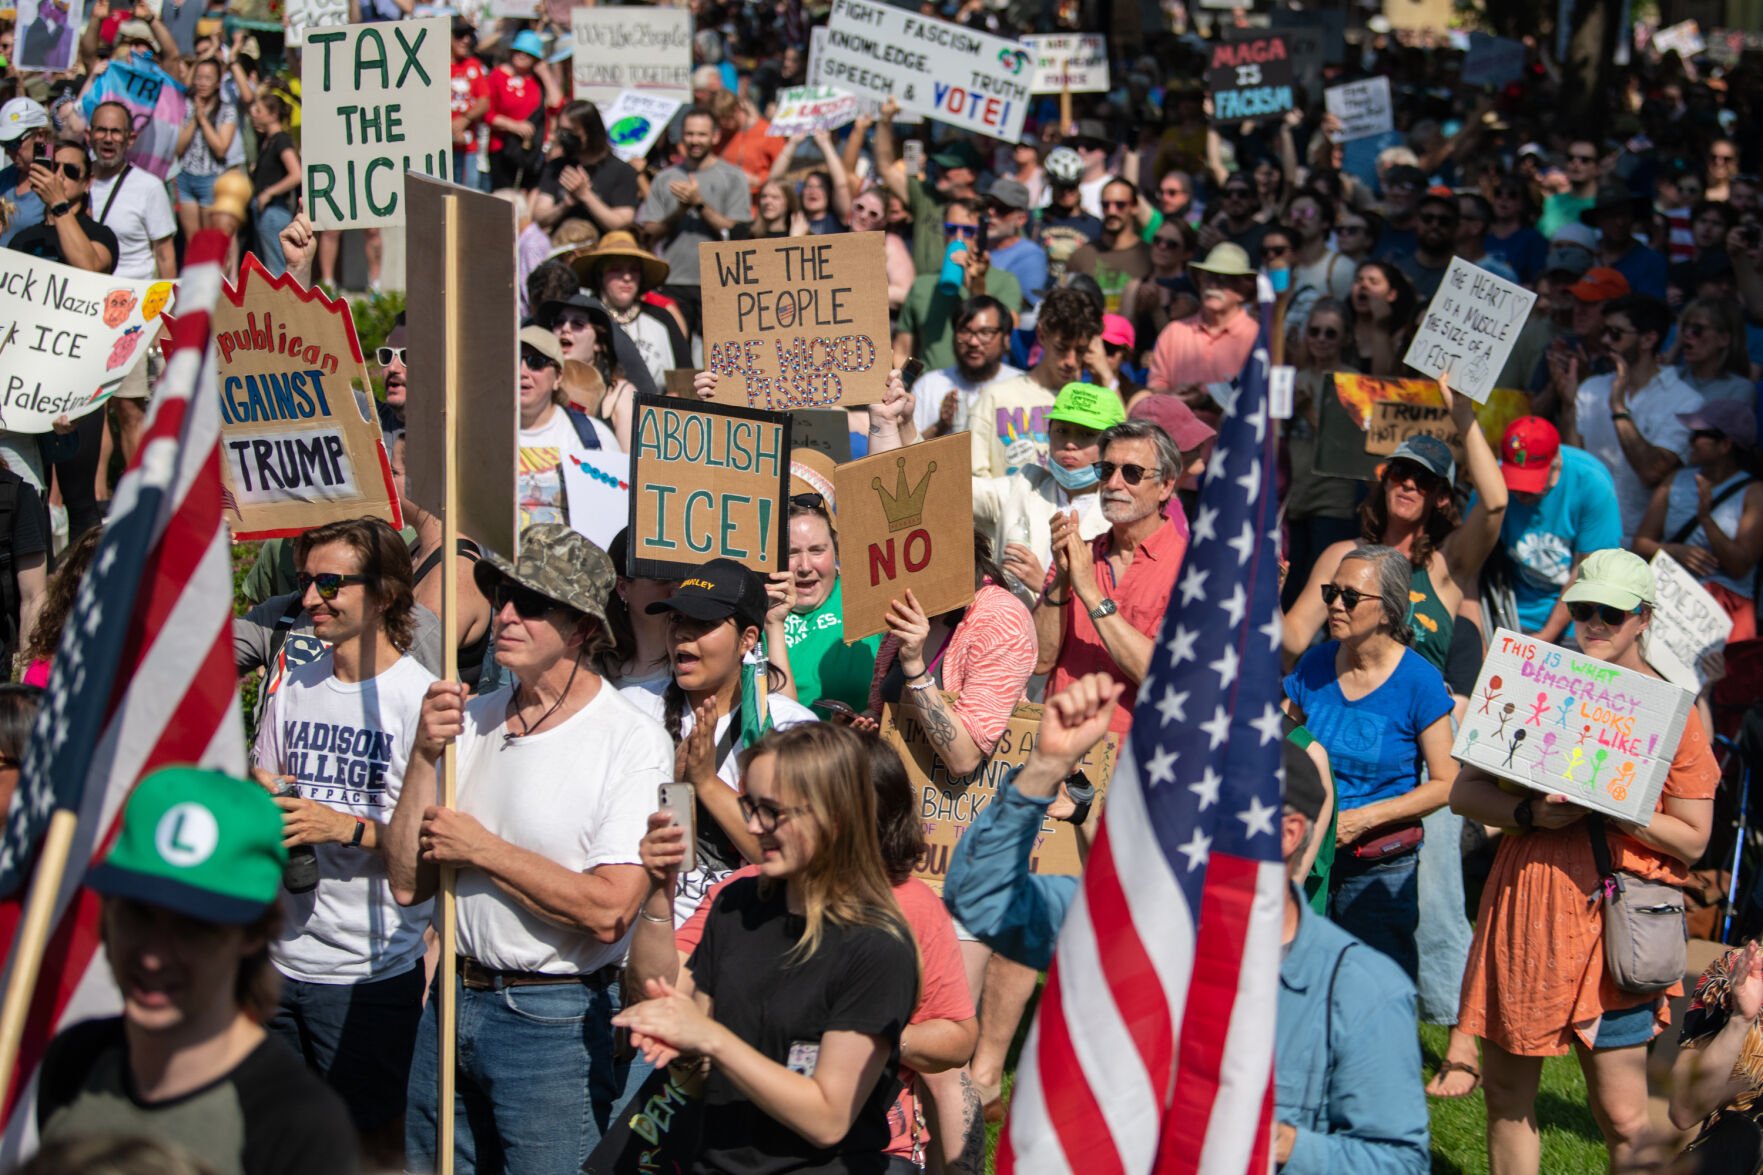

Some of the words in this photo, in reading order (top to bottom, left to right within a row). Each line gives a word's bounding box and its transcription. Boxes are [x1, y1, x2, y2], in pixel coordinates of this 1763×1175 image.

[834, 1, 886, 27] FIGHT
[903, 19, 983, 55] FASCISM
[308, 27, 432, 92] TAX
[1212, 37, 1286, 69] MAGA
[1235, 63, 1262, 86] IS
[824, 59, 895, 94] SPEECH
[903, 84, 915, 100] &
[934, 81, 1011, 136] VOTE!
[970, 71, 1027, 100] TRUTH
[337, 104, 405, 146] THE
[308, 149, 447, 222] RIC
[715, 249, 759, 287] WE
[775, 244, 833, 282] THE
[43, 274, 100, 317] Nazis
[737, 287, 853, 333] PEOPLE
[1470, 273, 1512, 309] HEART
[29, 325, 88, 359] ICE
[216, 312, 339, 375] publican
[1440, 321, 1468, 346] SIZE
[1468, 340, 1484, 353] OF
[1483, 345, 1493, 361] A
[1462, 306, 1510, 342] MUSCLE
[710, 339, 766, 377] ARE
[776, 334, 876, 374] WICKED
[1424, 344, 1462, 374] FIST
[746, 372, 843, 411] PISSED
[229, 435, 345, 491] TRUMP
[637, 408, 783, 477] ABOLISH
[644, 483, 773, 563] ICE!
[868, 529, 932, 587] NO
[1502, 637, 1537, 661] THIS
[1543, 651, 1562, 669] IS
[1570, 659, 1622, 685] WHAT
[1520, 660, 1642, 715] DEMOCRACY
[1580, 702, 1637, 737] LOOKS
[287, 751, 390, 790] OLLEGE
[170, 812, 194, 853] L
